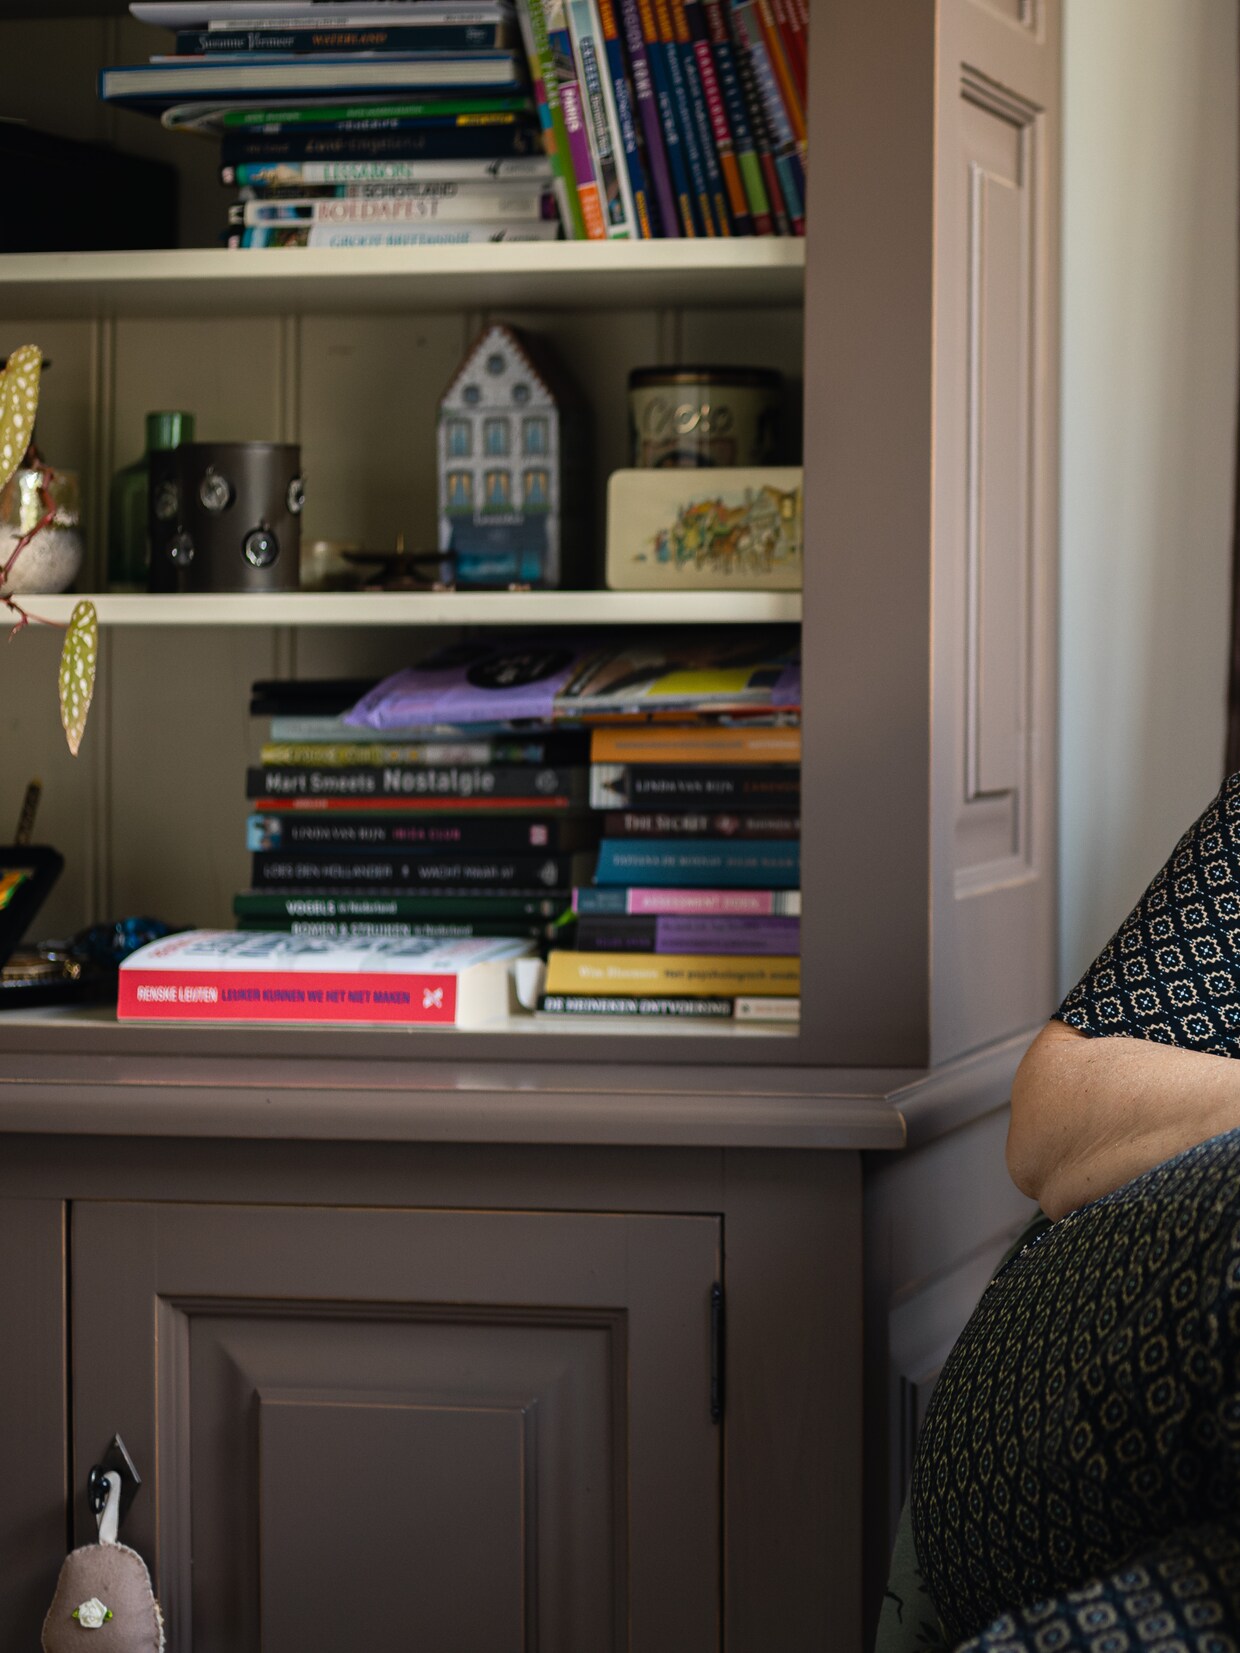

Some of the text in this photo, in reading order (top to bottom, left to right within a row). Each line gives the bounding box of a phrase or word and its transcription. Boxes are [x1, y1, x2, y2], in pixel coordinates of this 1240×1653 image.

[198, 36, 244, 51] Suzanne
[248, 31, 296, 51] Vermeer
[699, 46, 727, 140] BARCELONA
[716, 45, 748, 138] BERLIJN
[323, 161, 414, 179] LISSABON
[362, 182, 458, 199] SCHOTLAND
[318, 199, 440, 222] BOEDAPEST
[265, 768, 495, 797] Mart Smeets Nostalgie
[624, 814, 652, 831] THE
[656, 814, 709, 831] SECRET
[295, 863, 320, 879] DEN
[321, 863, 393, 879] HOLLANDER
[418, 863, 461, 879] WACHT
[285, 899, 337, 916] VOGELS
[137, 985, 411, 1005] RENSKE LEIJTEN LEUKER KUNNEN WE HET NIET MAKEN
[544, 996, 565, 1013] DE
[566, 996, 637, 1014] HEINEKEN
[639, 996, 732, 1015] ONTVOERING
